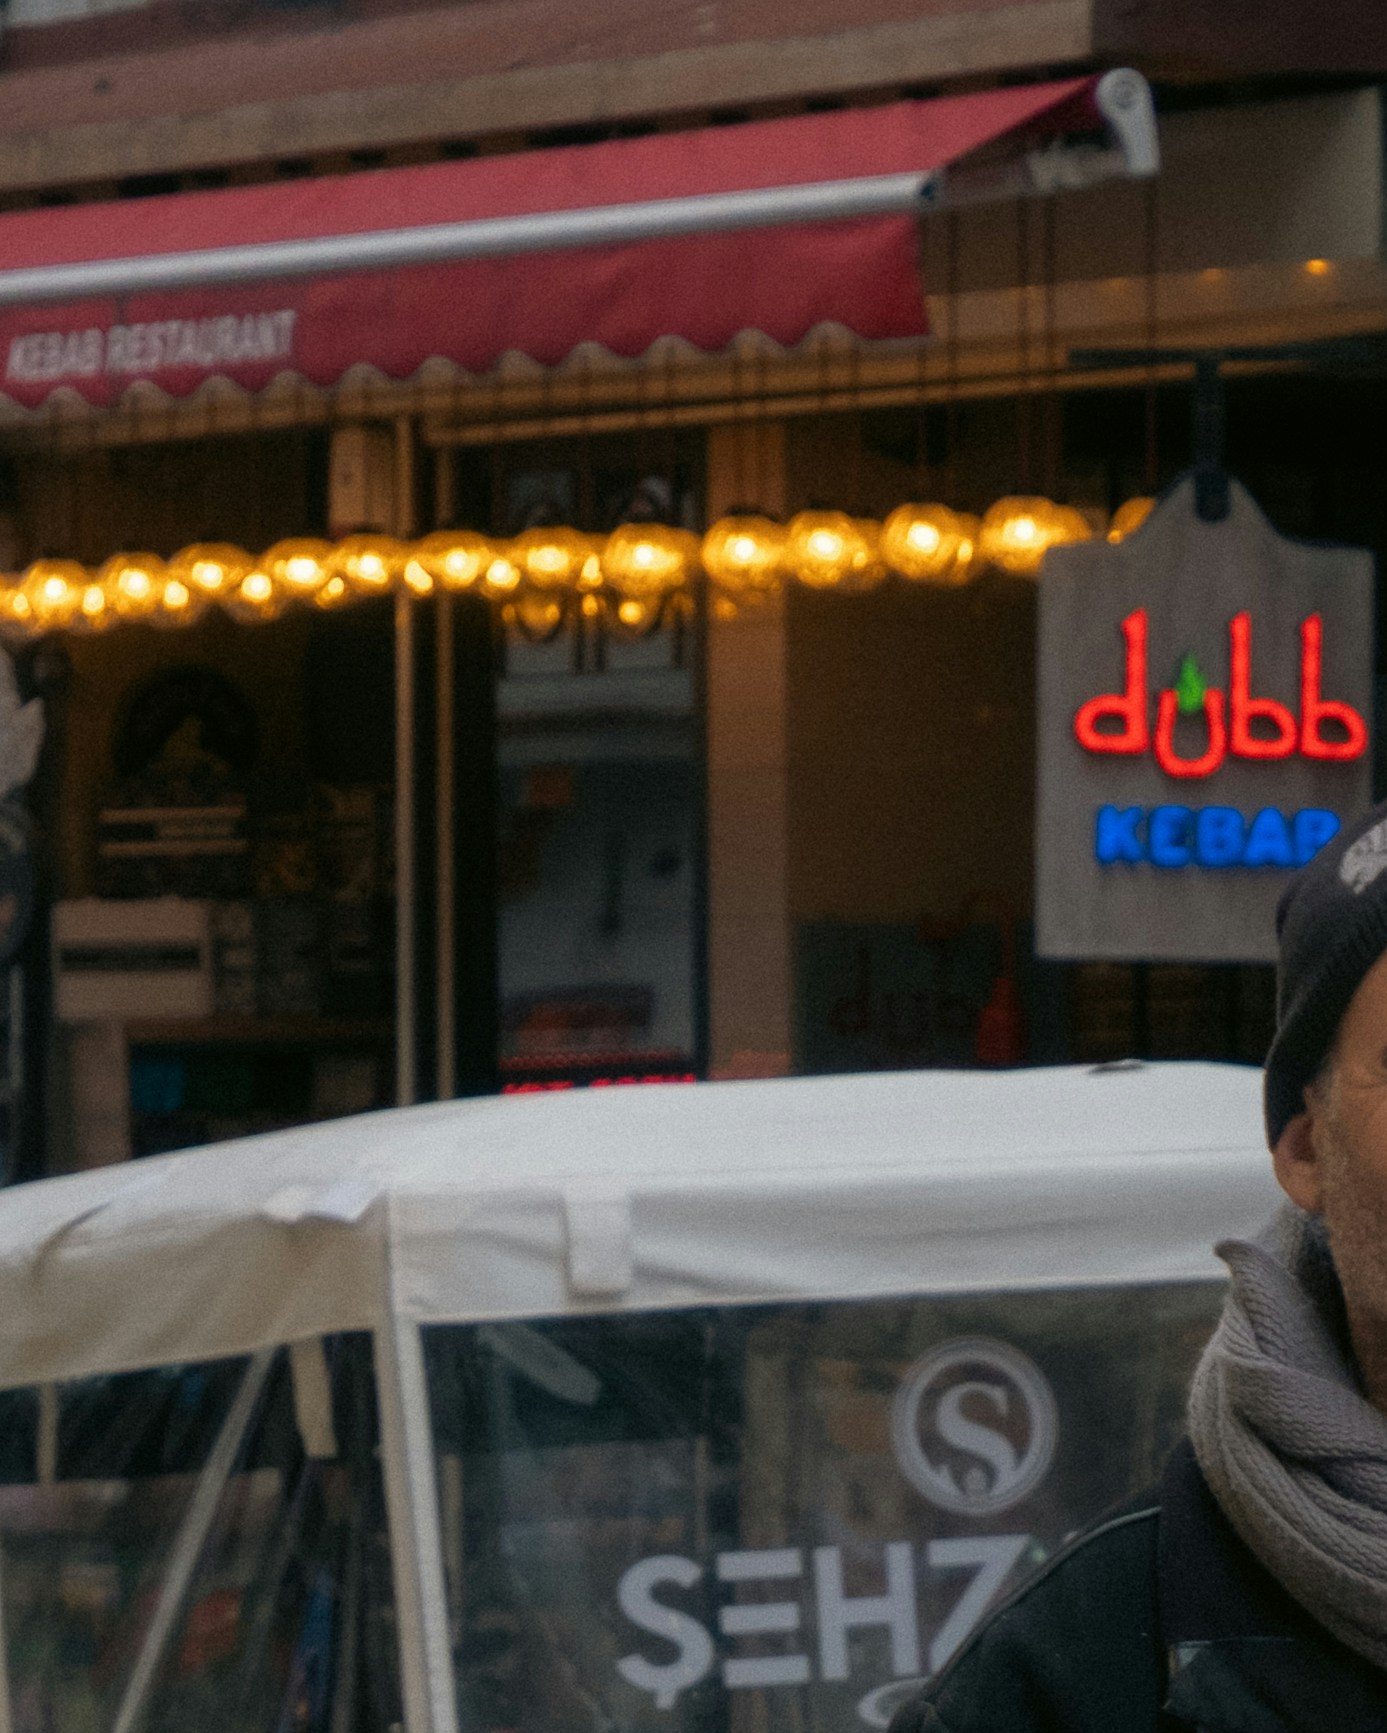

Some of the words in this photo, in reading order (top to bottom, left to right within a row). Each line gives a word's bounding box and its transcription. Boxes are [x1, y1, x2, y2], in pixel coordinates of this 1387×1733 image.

[6, 326, 104, 382] KEBAB
[106, 307, 297, 373] RESTAURANT
[1073, 608, 1368, 778] dubb
